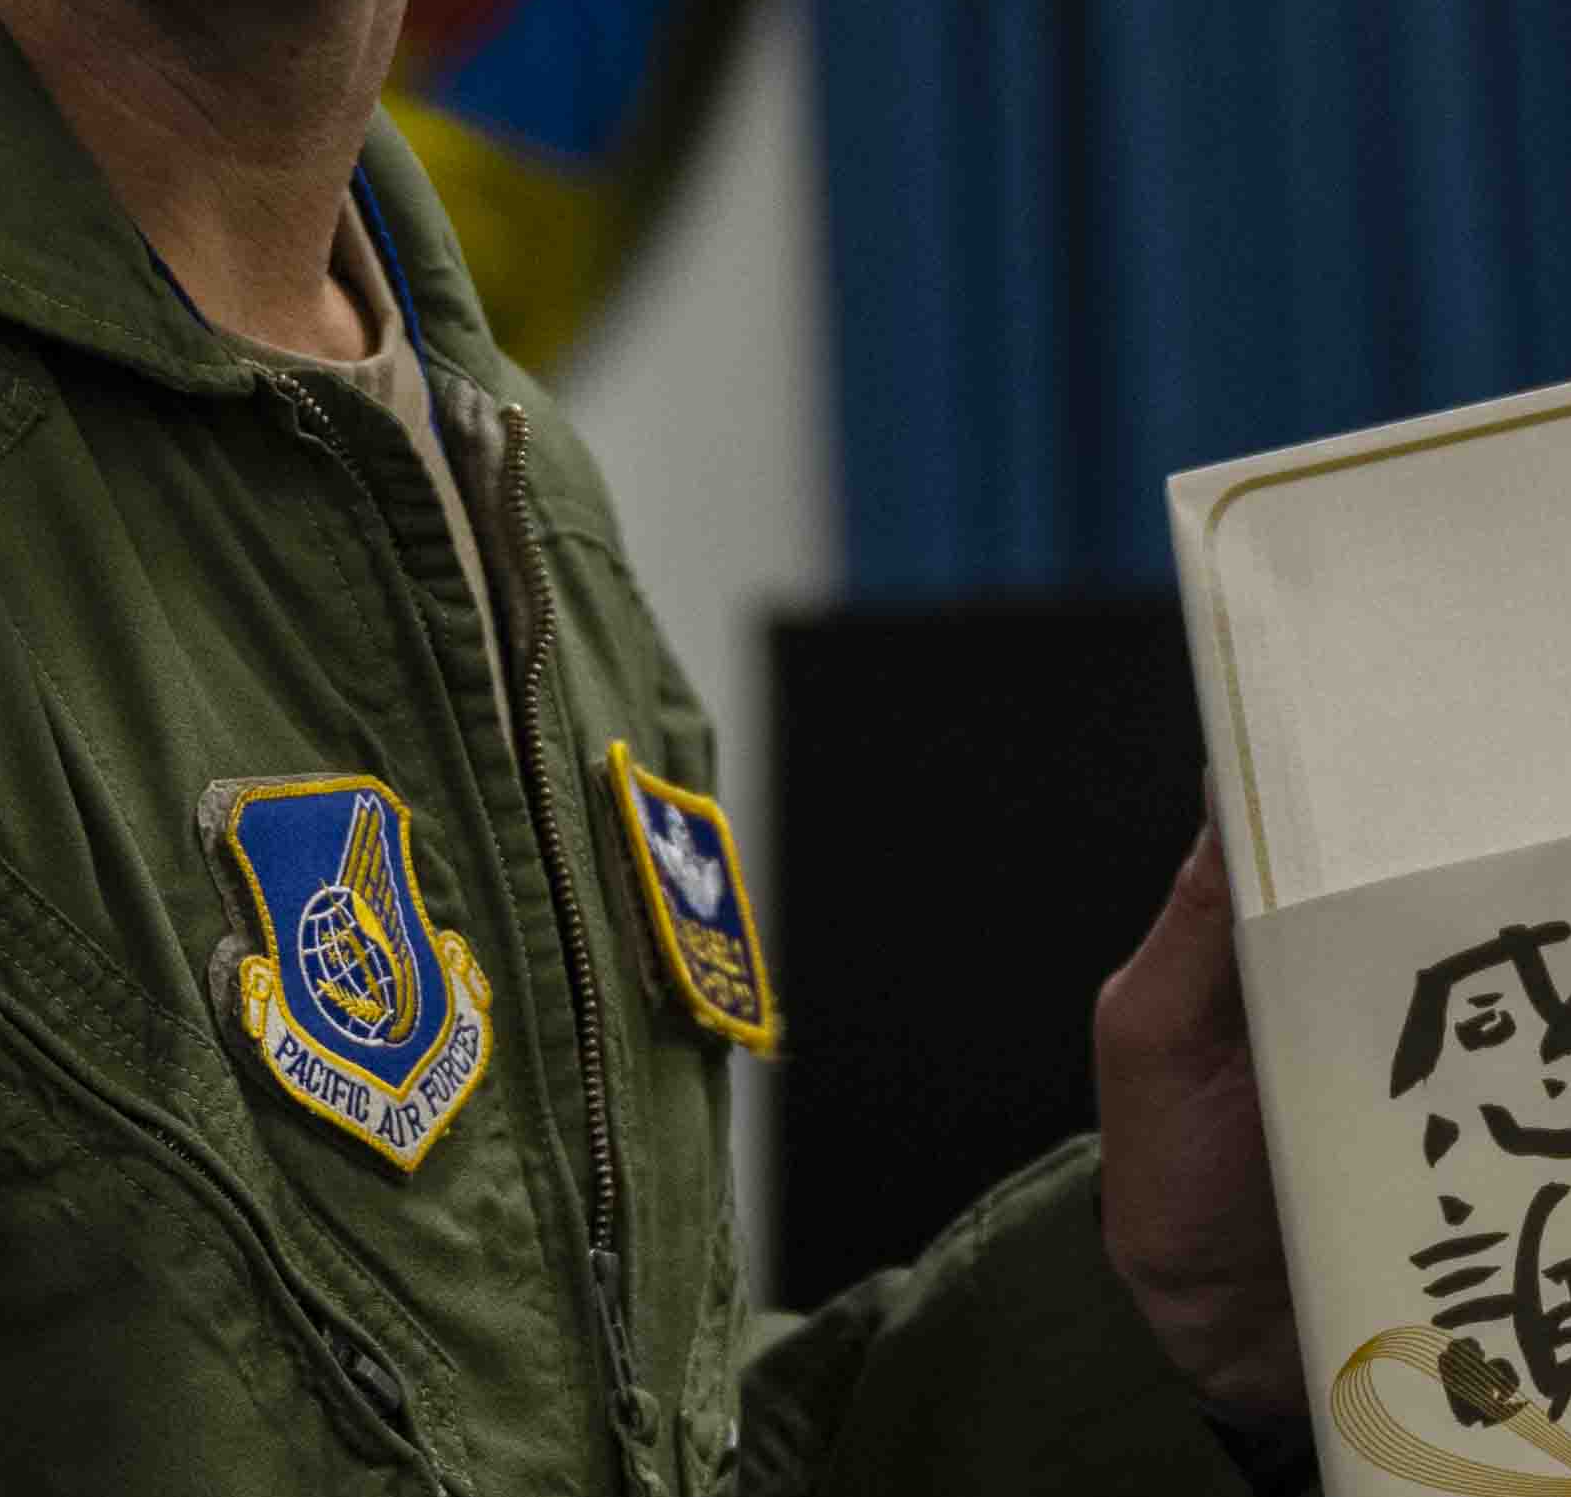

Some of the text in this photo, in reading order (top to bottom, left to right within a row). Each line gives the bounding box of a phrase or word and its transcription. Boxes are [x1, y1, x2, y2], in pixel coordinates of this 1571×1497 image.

[275, 1015, 480, 1148] PACIFIC AIR FORCES
